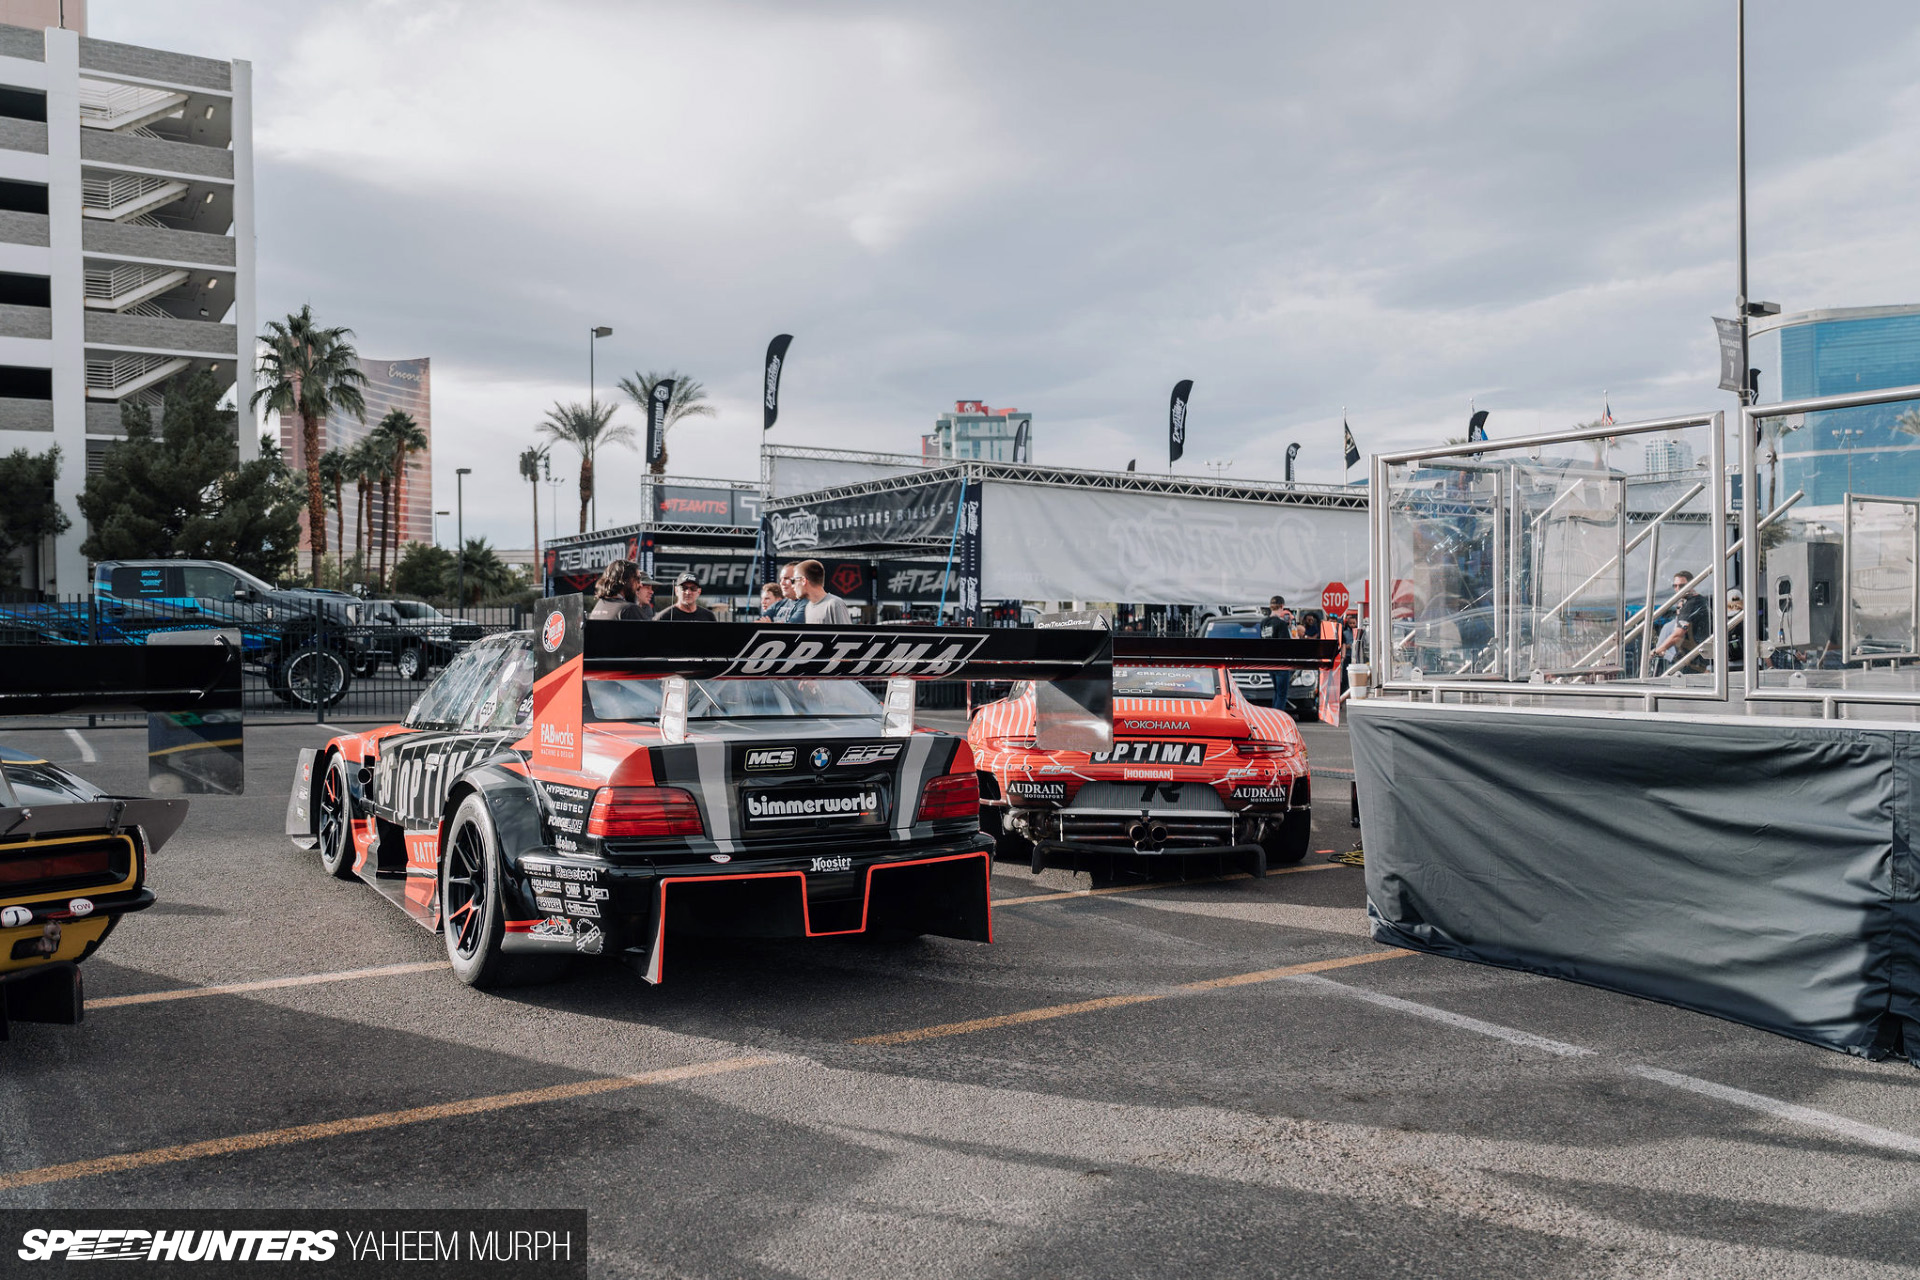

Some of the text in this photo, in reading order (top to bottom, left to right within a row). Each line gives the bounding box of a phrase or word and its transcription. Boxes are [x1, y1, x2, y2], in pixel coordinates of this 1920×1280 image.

[388, 362, 421, 382] Encore
[1322, 592, 1349, 607] STOP
[740, 640, 964, 674] OPTIMA
[1124, 719, 1191, 730] YOKOHAMA
[541, 723, 574, 746] FABworks
[748, 750, 794, 765] MCS
[379, 752, 394, 806] 36
[546, 784, 589, 800] HYPERCOILS
[1008, 783, 1064, 795] AUDRAIN
[1024, 792, 1064, 800] MOTORSPORT
[1233, 787, 1286, 799] AUDRAIN
[549, 800, 584, 814] WEISTEC
[748, 792, 878, 816] bimmerworld
[810, 855, 851, 871] Hoosier
[554, 865, 597, 881] Racetech
[531, 878, 561, 889] HOLINGER
[565, 885, 580, 896] OMP
[71, 903, 91, 911] TOW
[567, 902, 598, 915] tilton
[576, 925, 601, 951] SPEED
